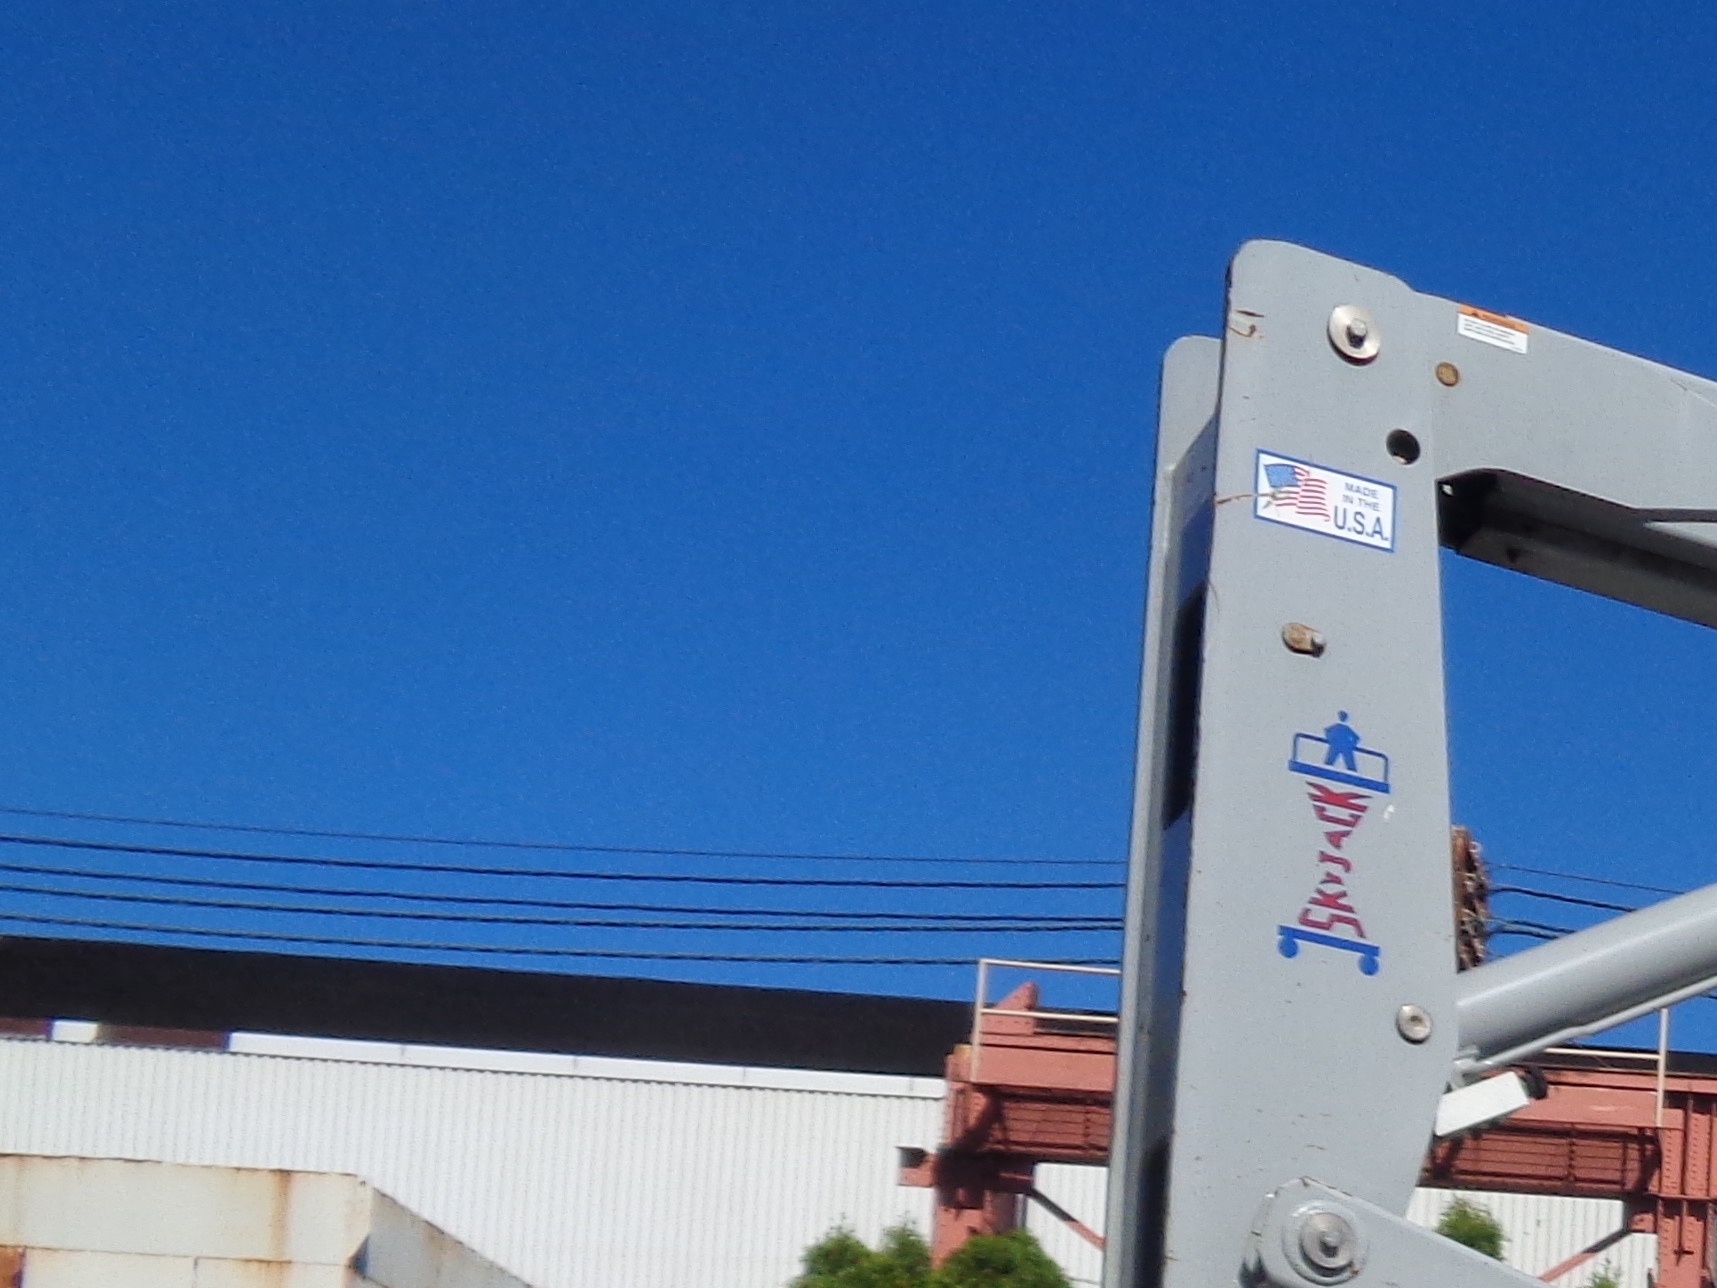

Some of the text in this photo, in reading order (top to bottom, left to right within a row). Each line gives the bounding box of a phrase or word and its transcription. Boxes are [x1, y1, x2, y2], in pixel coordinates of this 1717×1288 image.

[1344, 482, 1379, 500] MADE
[1342, 494, 1381, 512] IN THE
[1334, 505, 1389, 541] U.S.A.
